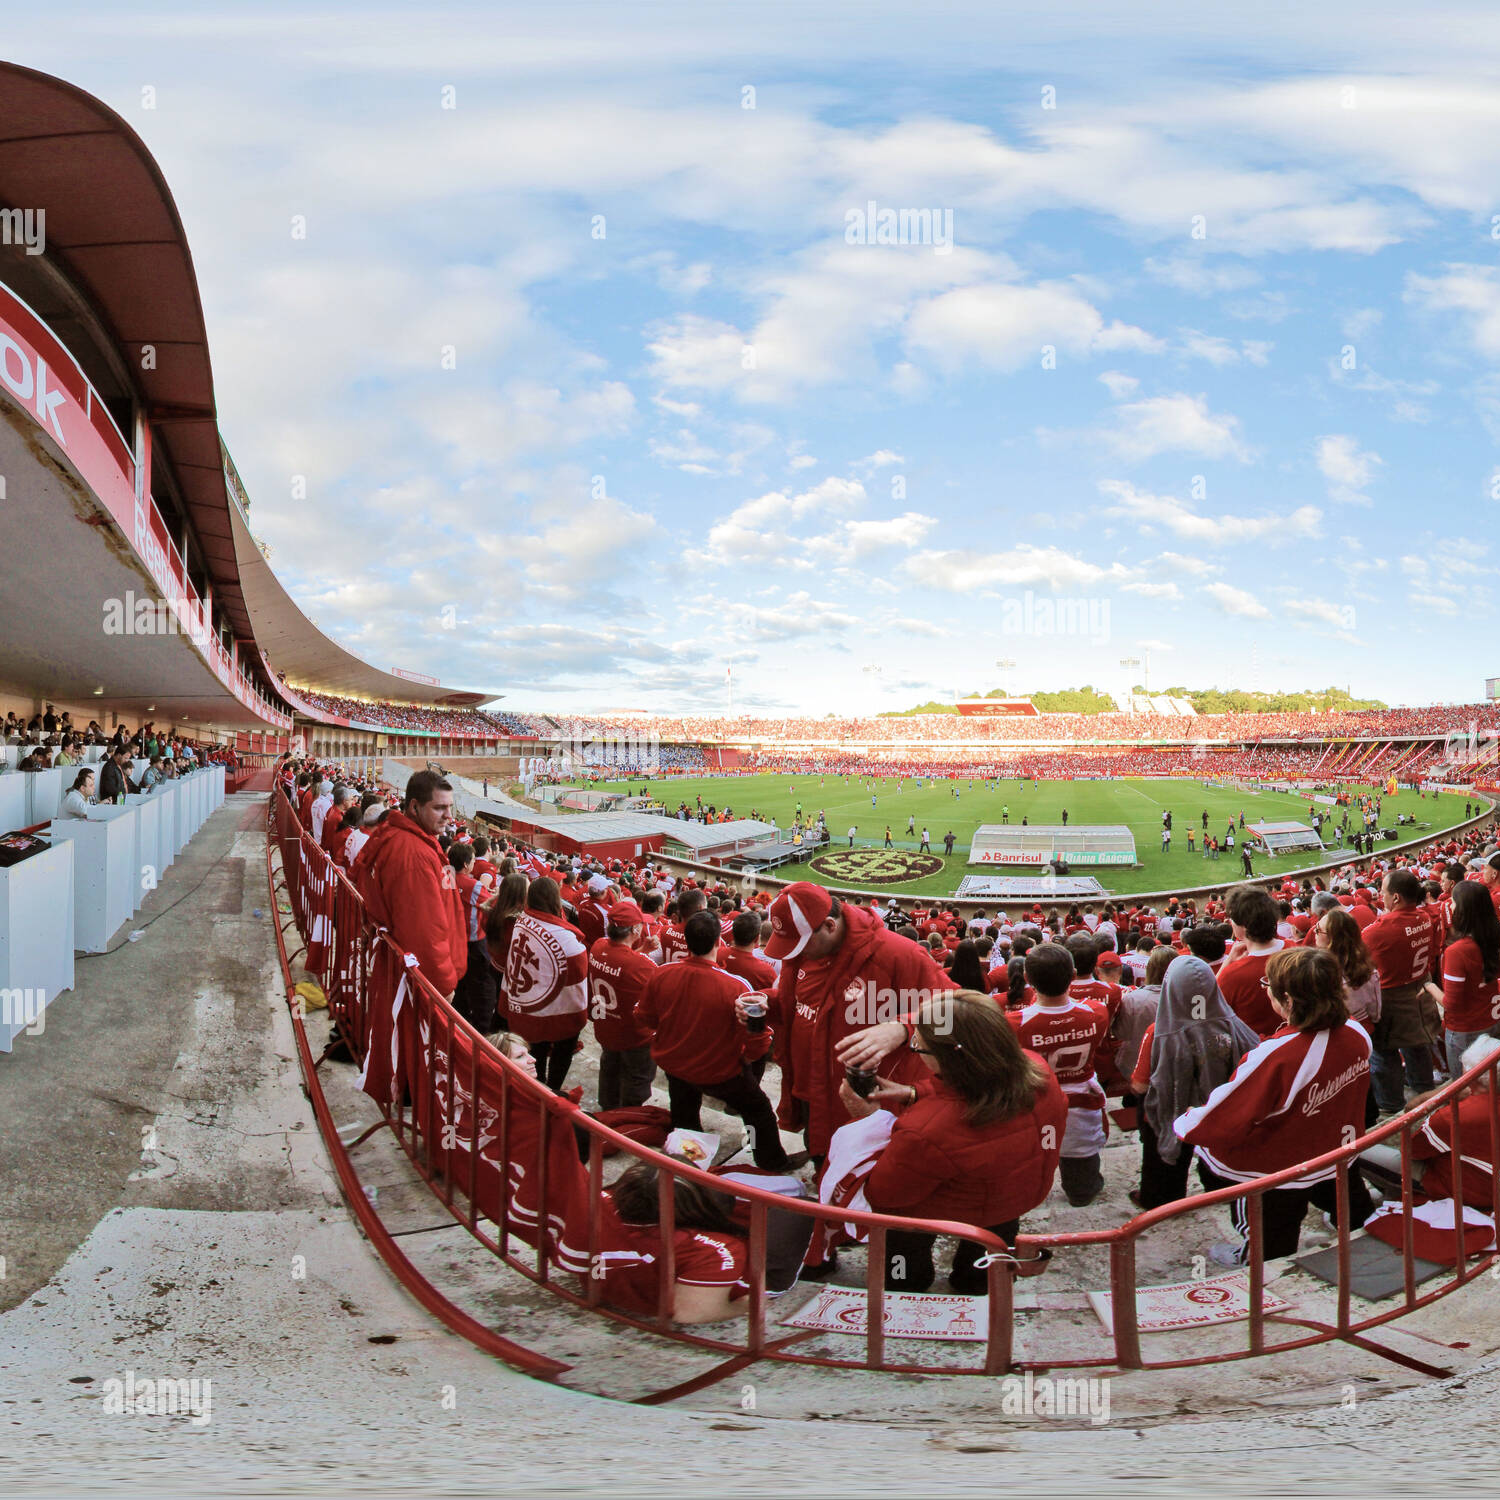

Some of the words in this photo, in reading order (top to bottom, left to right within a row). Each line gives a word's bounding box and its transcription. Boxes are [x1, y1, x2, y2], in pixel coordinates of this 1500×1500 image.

[993, 852, 1042, 862] Banrisul
[589, 953, 621, 977] Banrisul
[1411, 946, 1429, 979] 5
[1031, 1022, 1097, 1047] Banrisul
[1302, 1056, 1370, 1114] Internacion
[820, 1288, 893, 1300] CAMPEO
